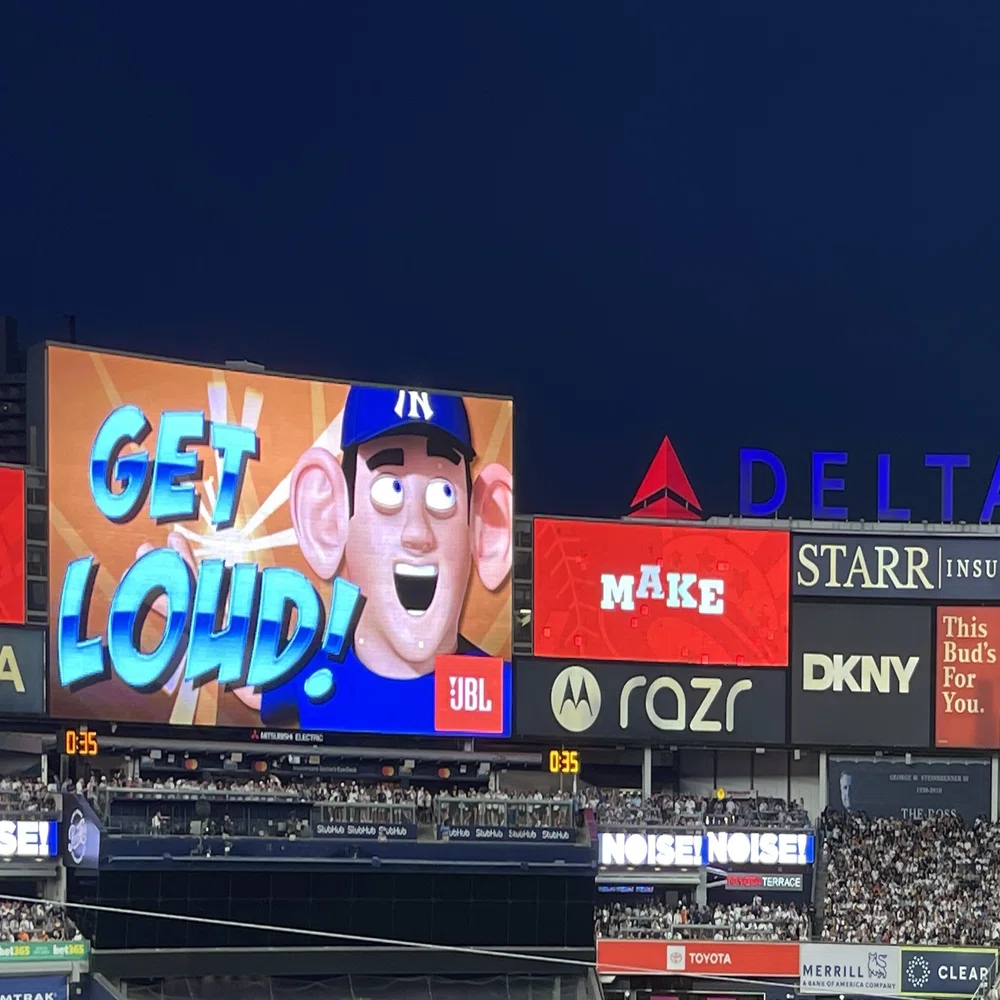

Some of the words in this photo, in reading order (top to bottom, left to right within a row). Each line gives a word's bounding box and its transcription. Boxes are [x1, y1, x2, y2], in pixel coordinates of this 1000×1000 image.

[89, 404, 256, 526] GET
[797, 543, 934, 589] STARR
[601, 565, 724, 614] MAKE
[57, 547, 362, 702] LOUD!
[943, 616, 988, 638] This
[943, 641, 997, 663] Bud's
[803, 654, 919, 692] DKNY
[943, 666, 976, 688] For
[449, 676, 492, 712] JBL
[620, 676, 752, 731] razr
[942, 691, 985, 713] You.
[65, 730, 98, 755] 0:35
[295, 733, 324, 742] ELECTRIC
[549, 751, 579, 774] 0:35
[901, 807, 924, 821] THE
[601, 833, 703, 865] NOISE!
[707, 831, 808, 864] NOISE!
[762, 877, 801, 888] TERRACE
[689, 952, 732, 965] TOYOTA
[803, 965, 864, 978] MERRILL
[938, 966, 988, 980] CLEAR
